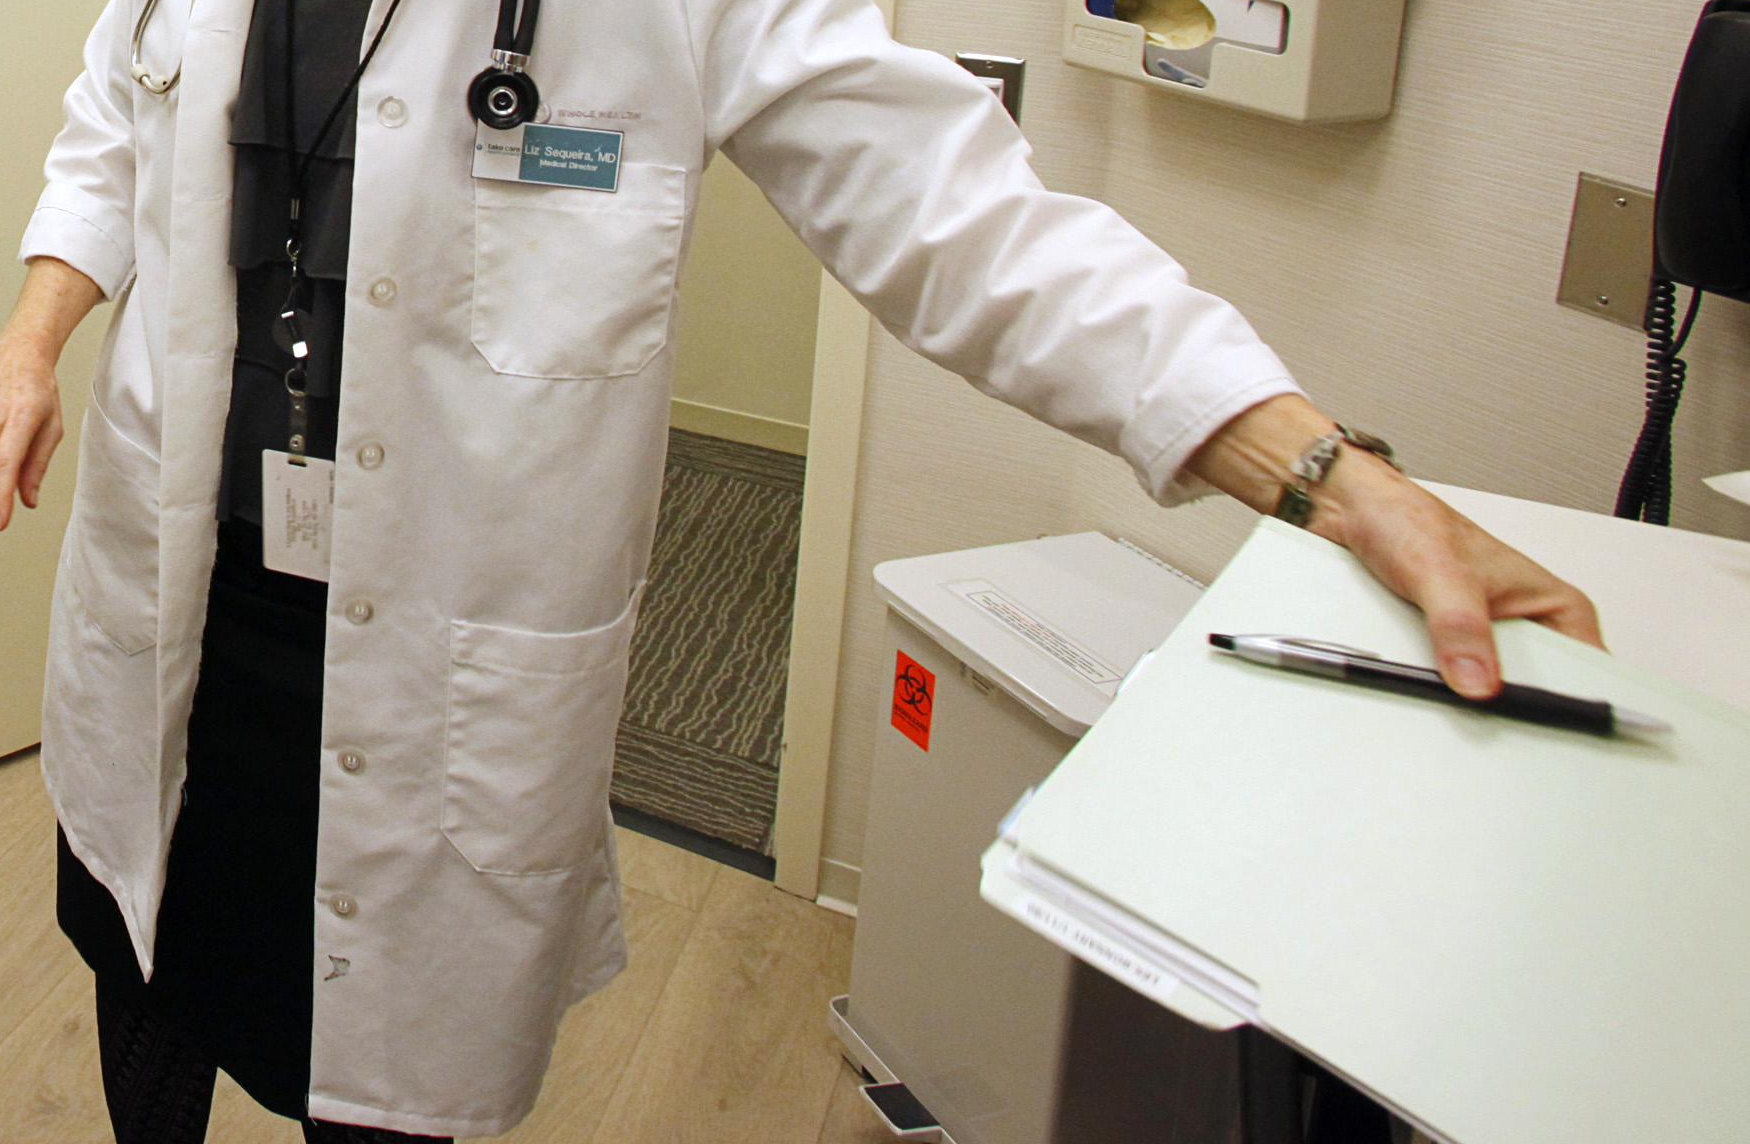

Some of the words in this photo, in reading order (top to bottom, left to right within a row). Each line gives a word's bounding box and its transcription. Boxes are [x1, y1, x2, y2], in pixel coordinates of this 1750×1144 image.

[488, 143, 504, 152] take
[505, 145, 521, 153] care
[524, 145, 540, 156] Liz
[544, 146, 594, 162] Sequeira,
[598, 152, 616, 163] MD
[540, 159, 567, 168] Medical
[569, 162, 598, 172] Director
